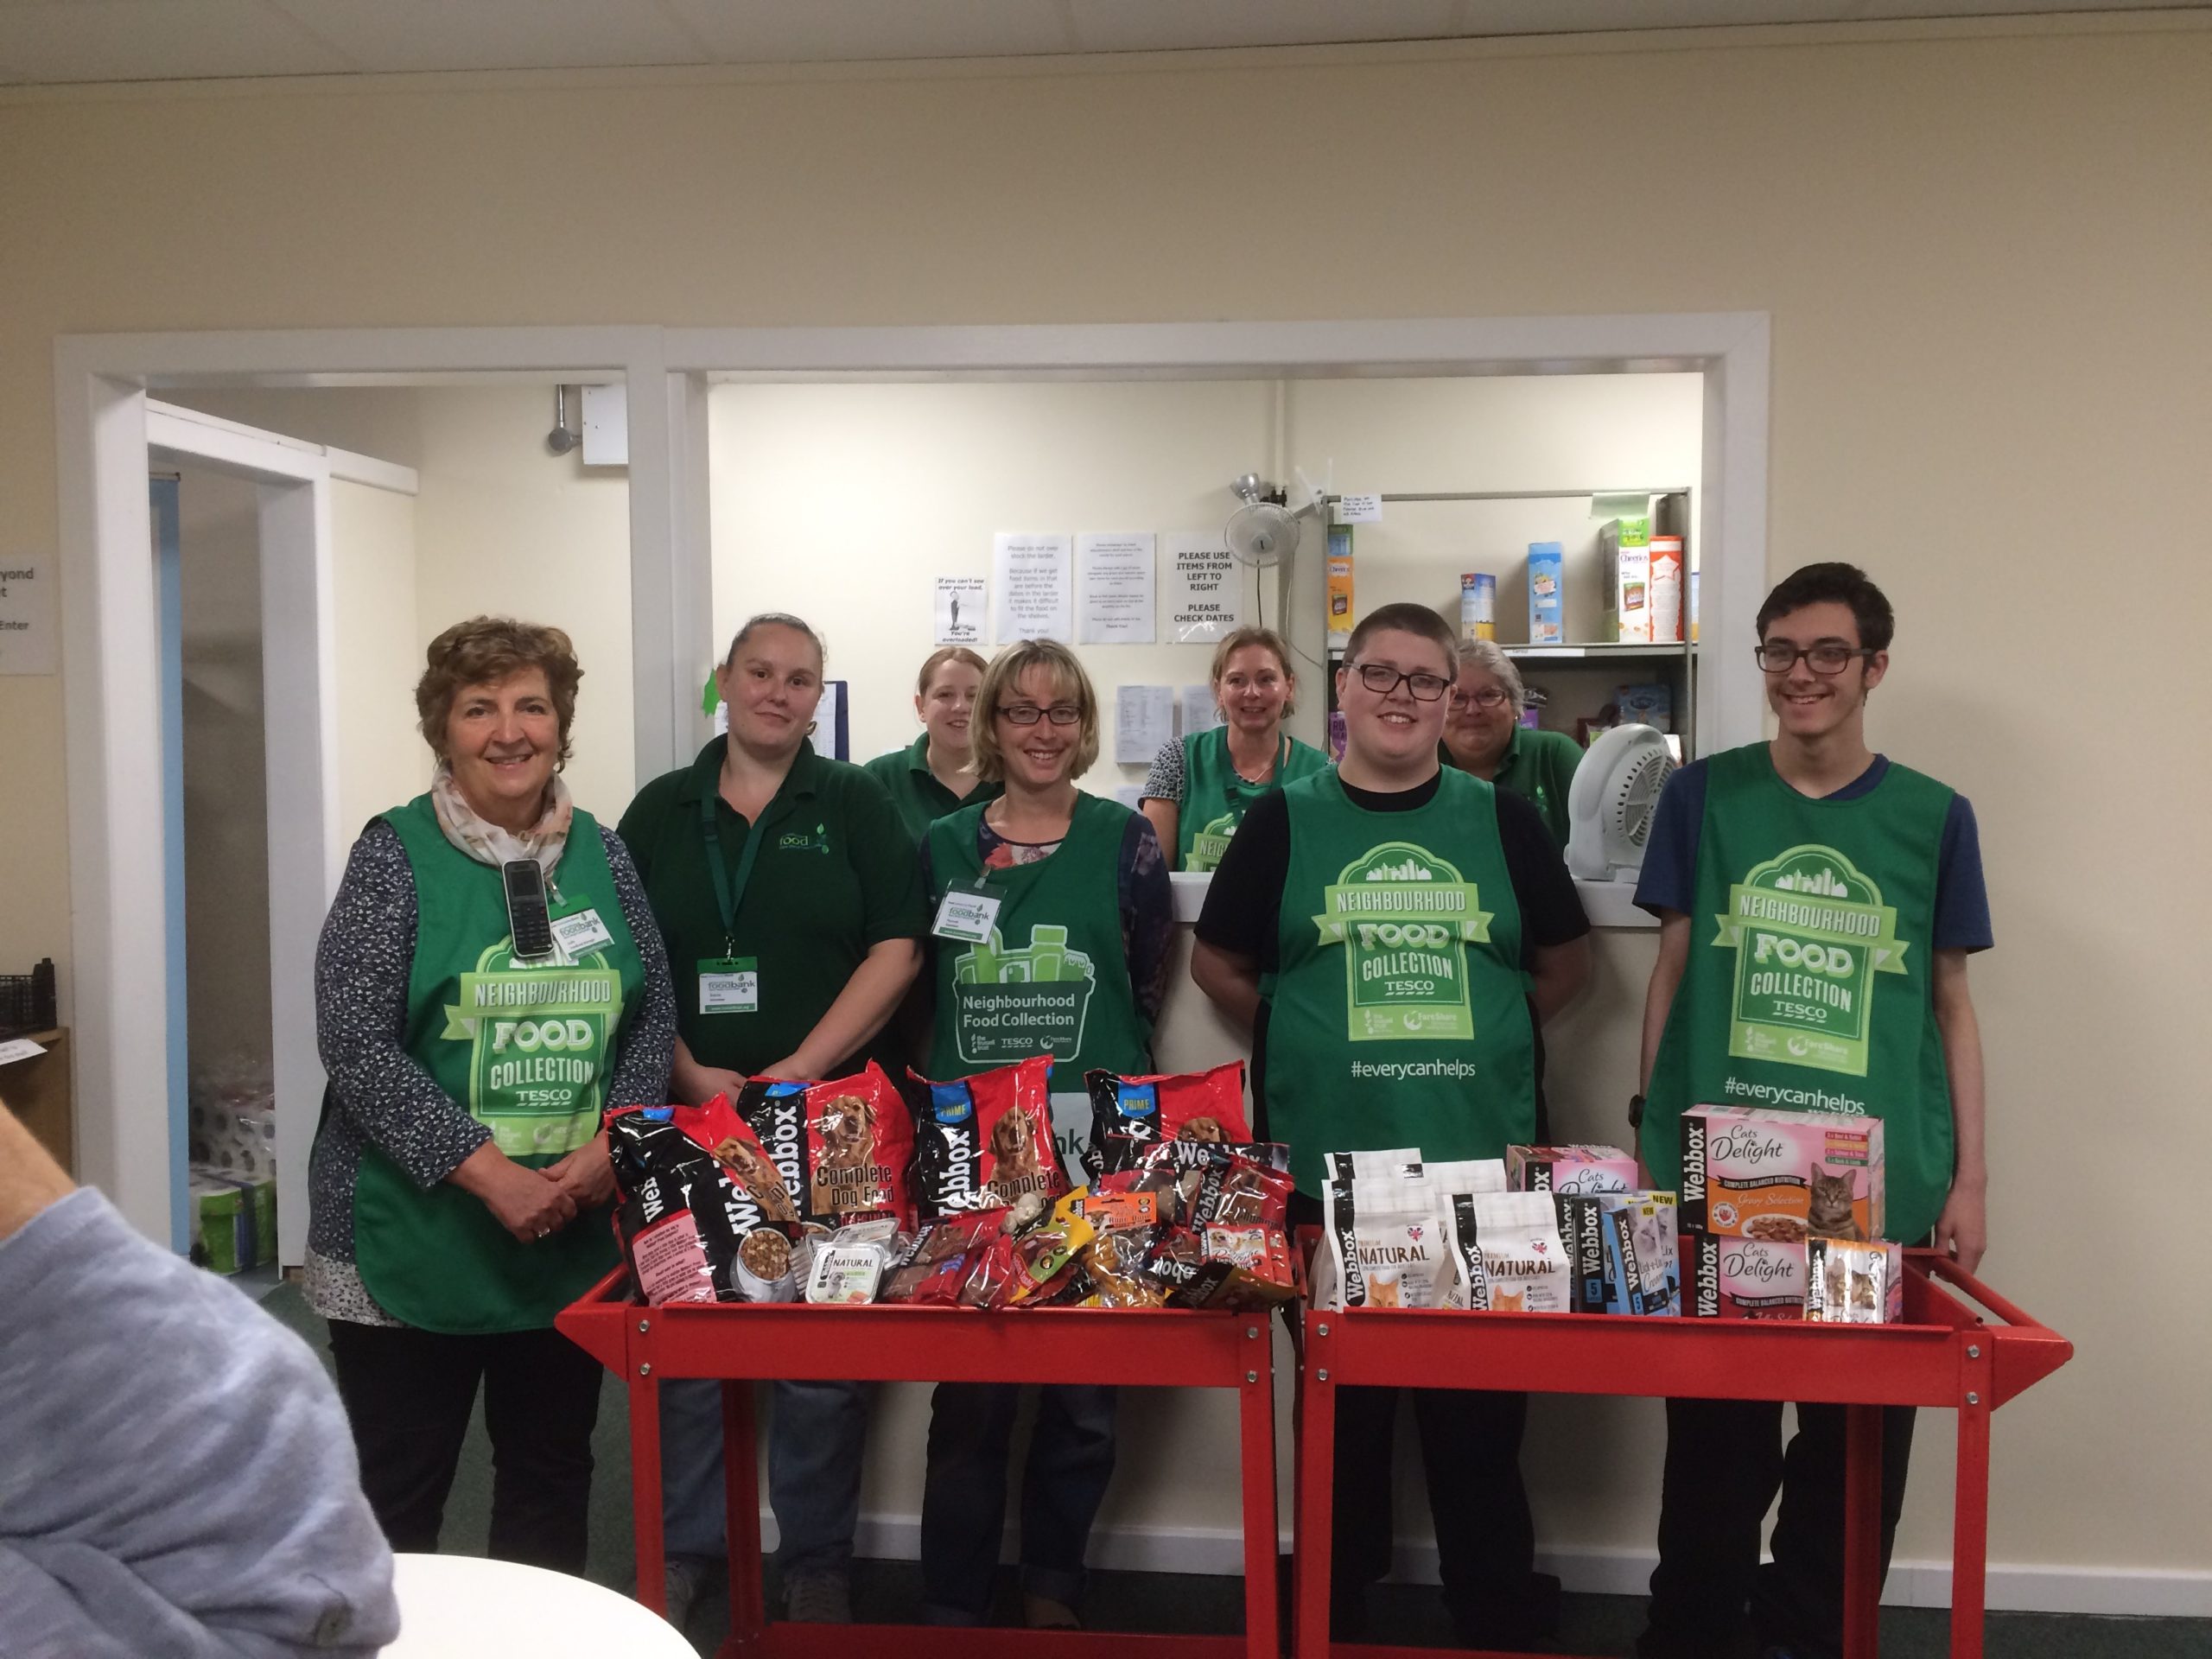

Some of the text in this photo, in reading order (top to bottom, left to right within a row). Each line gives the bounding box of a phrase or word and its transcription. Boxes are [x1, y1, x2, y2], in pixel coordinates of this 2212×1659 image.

[0, 567, 34, 582] yond
[1337, 890, 1466, 913] NEIGHBOURHOOD
[950, 907, 989, 920] foodbank
[1739, 894, 1881, 938] NEIGHBOURHOOD
[1357, 924, 1449, 950] FOOD
[1363, 951, 1453, 982] COLLECTION
[1754, 933, 1854, 978] FOOD
[475, 980, 611, 1007] NEIGHBOURHOOD
[1384, 980, 1434, 992] TESCO
[1751, 972, 1853, 1013] COLLECTION
[963, 994, 1075, 1012] Neighbourhood
[1773, 1001, 1827, 1020] TESCO
[963, 1012, 1075, 1027] Food Collection
[493, 1020, 594, 1053] FOOD
[491, 1058, 594, 1090] COLLECTION
[1351, 1058, 1476, 1080] #everycanhelps
[516, 1090, 572, 1103] TESCO
[1123, 1098, 1149, 1110] PRIME
[1725, 1077, 1866, 1116] #everycanhelps
[1731, 1124, 1758, 1140] Cats
[1710, 1136, 1783, 1165] Delight
[817, 1163, 893, 1187] Complete
[1579, 1168, 1605, 1184] Cats
[1683, 1128, 1706, 1202] Webbox
[988, 1170, 1059, 1198] Complete
[832, 1188, 858, 1207] Dog
[1192, 1168, 1224, 1234] Webbox
[1652, 1195, 1674, 1205] NEW
[1737, 1192, 1804, 1208] Gravy Selection
[1643, 1207, 1654, 1216] NEW
[1581, 1206, 1601, 1275] Webbox
[1743, 1242, 1770, 1257] Cats
[834, 1259, 874, 1268] NATURAL
[1342, 1230, 1365, 1301] Webbox
[1359, 1245, 1430, 1265] NATURAL
[1618, 1218, 1639, 1291] Webbox
[1465, 1244, 1488, 1311] Webbox
[1484, 1260, 1556, 1277] NATURAL
[1698, 1243, 1718, 1317] Webbox
[1723, 1254, 1794, 1283] Delight
[1590, 1282, 1599, 1296] 5
